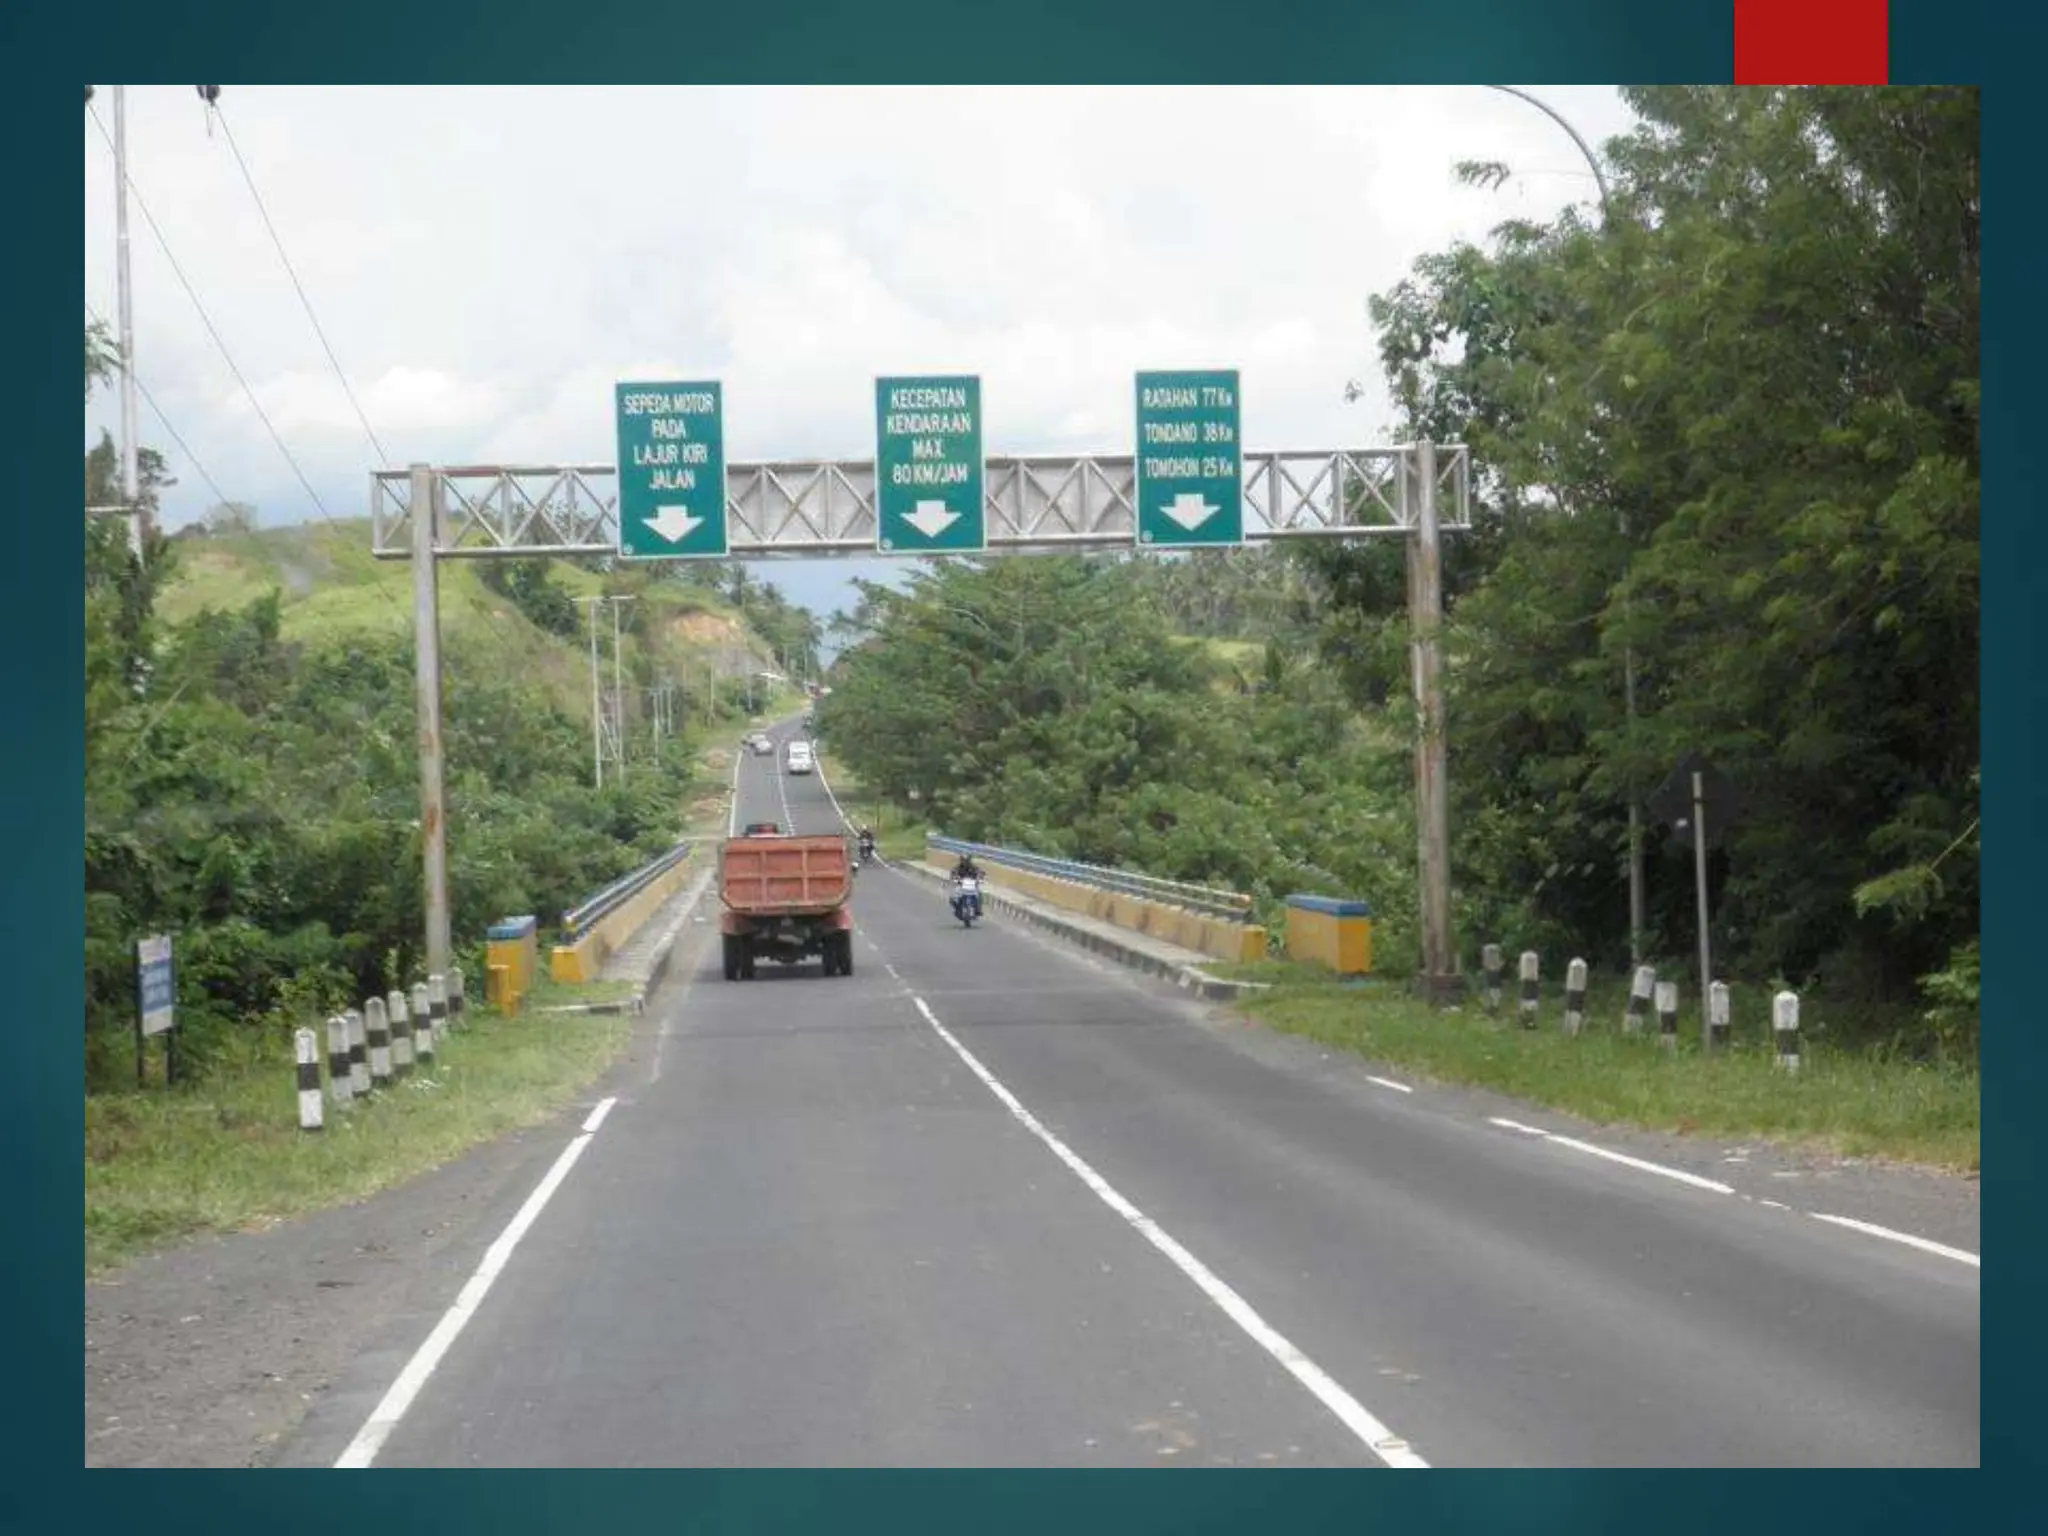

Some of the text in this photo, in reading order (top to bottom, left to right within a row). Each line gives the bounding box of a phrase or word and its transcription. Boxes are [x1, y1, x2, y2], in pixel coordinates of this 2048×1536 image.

[624, 392, 714, 415] SEPEDA MOTOR
[891, 387, 966, 409] KECEPATAN
[1143, 387, 1198, 408] RATAHAN
[651, 418, 687, 439] PADA
[886, 412, 972, 434] KENDARAAN
[1144, 422, 1198, 443] TONDANO
[633, 442, 708, 465] LAJUR KIRI
[1145, 457, 1200, 478] TOMOHON
[648, 468, 697, 489] JALAN
